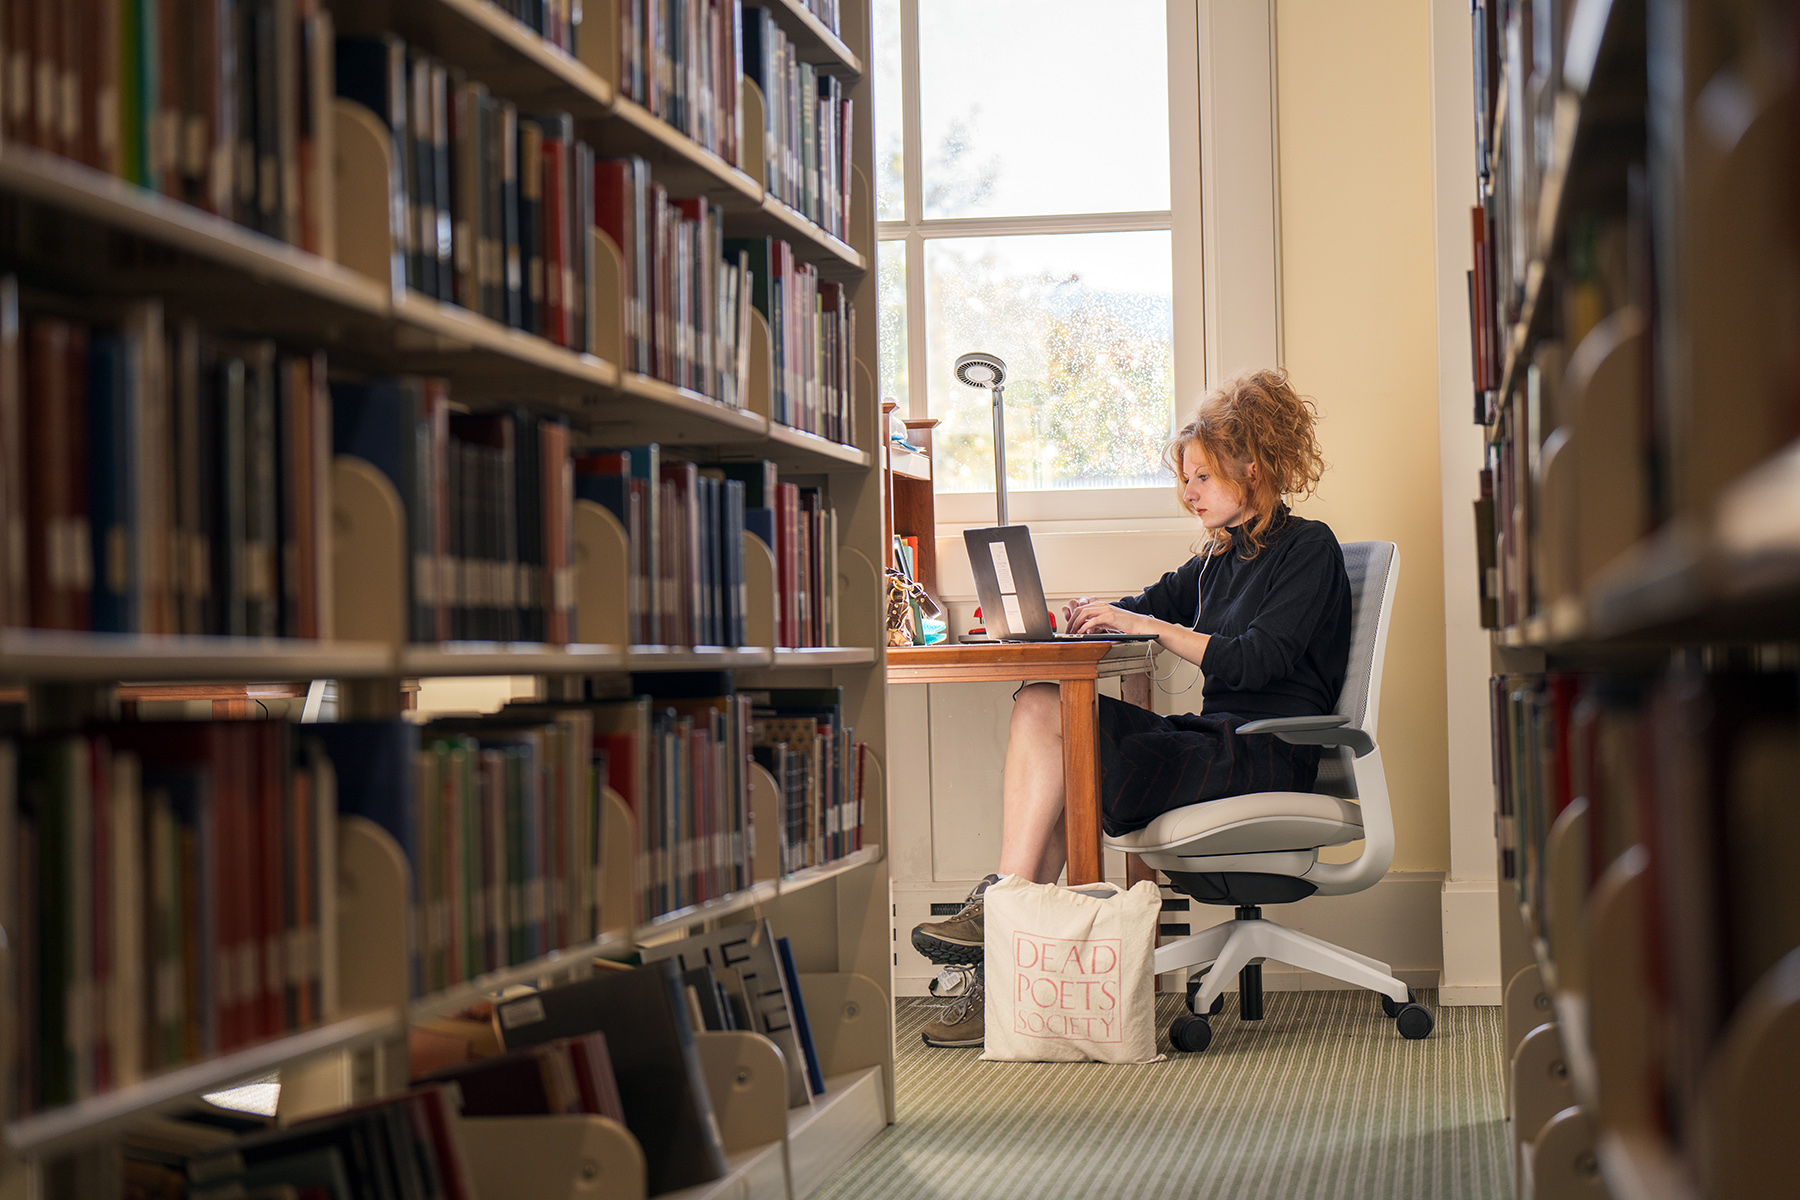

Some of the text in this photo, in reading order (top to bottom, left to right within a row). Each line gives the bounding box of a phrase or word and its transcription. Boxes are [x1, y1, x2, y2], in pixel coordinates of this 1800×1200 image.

[1017, 938, 1117, 974] DEAD
[1018, 973, 1116, 1010] POETS
[1017, 1010, 1115, 1038] SOCIETY
